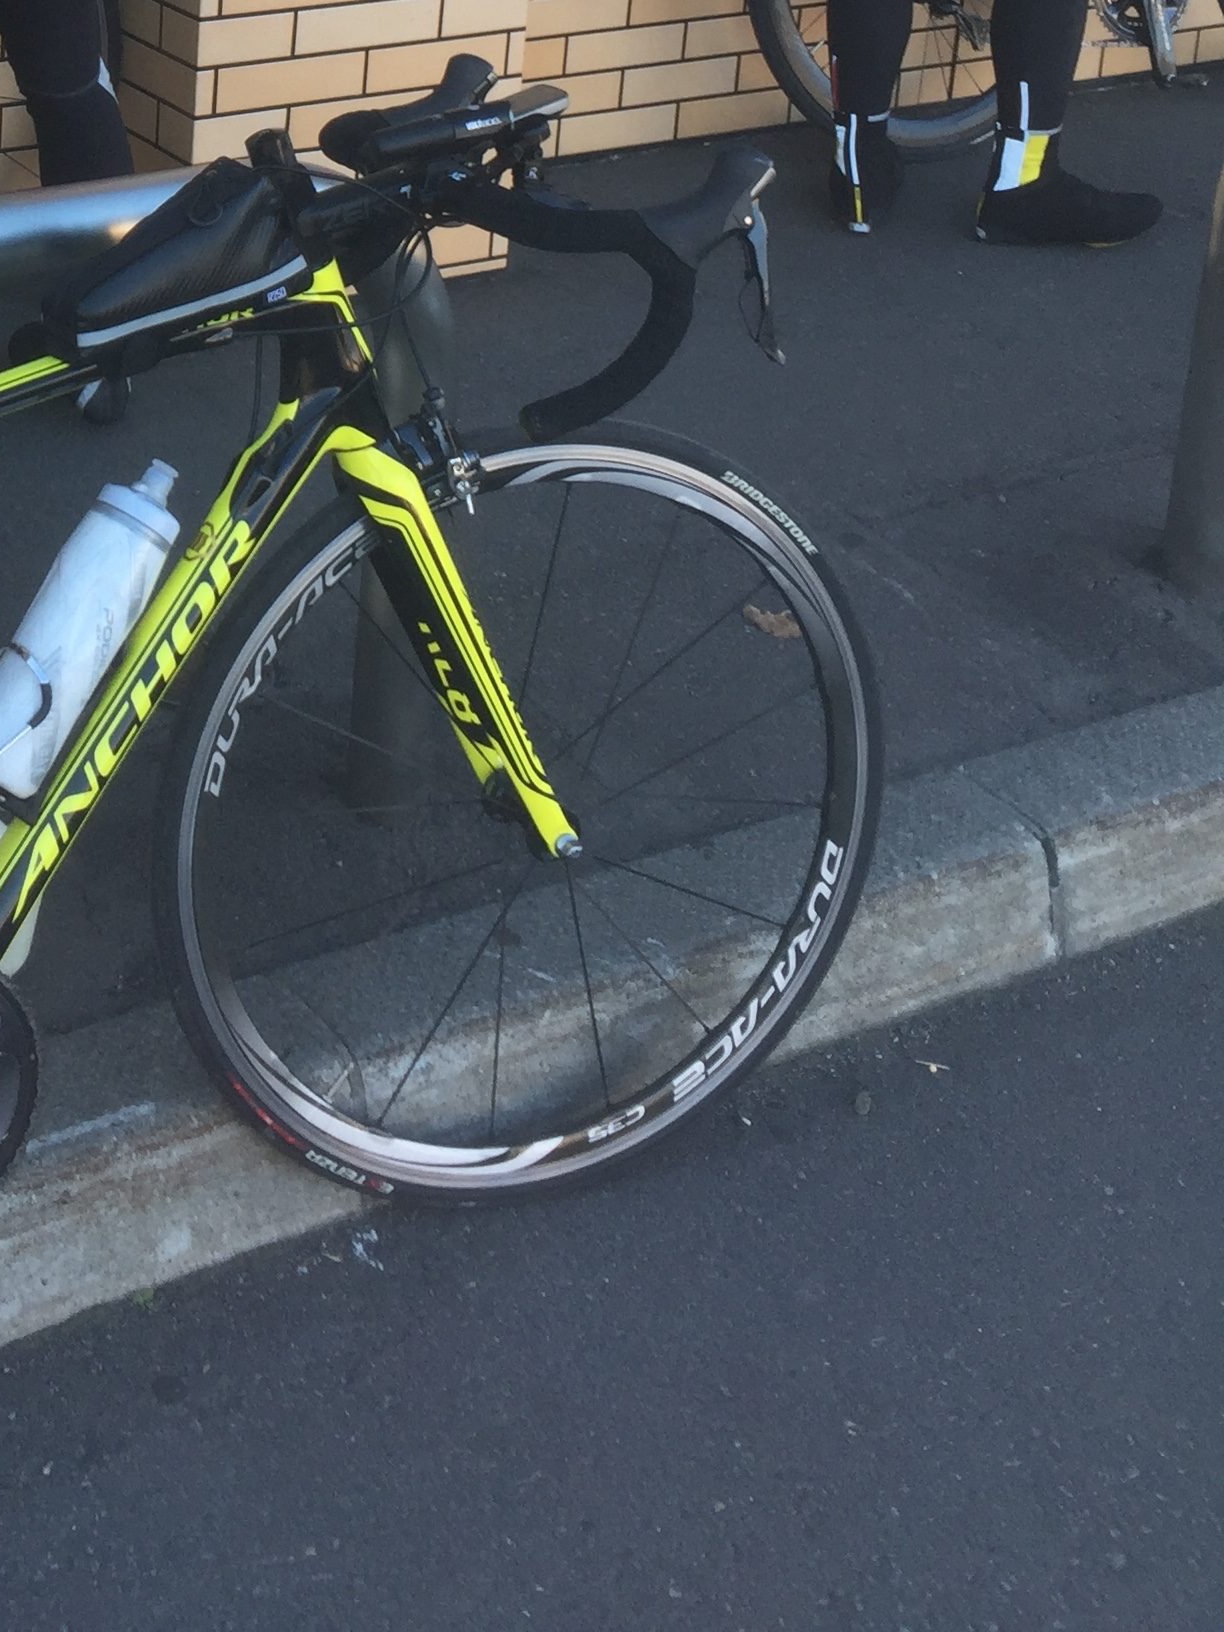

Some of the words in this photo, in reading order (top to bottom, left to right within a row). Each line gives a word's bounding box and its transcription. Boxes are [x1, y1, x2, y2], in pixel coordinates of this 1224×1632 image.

[720, 470, 819, 556] BRIDGESTONE
[13, 520, 255, 921] ANCHOR
[672, 839, 844, 1102] DURA-ACE
